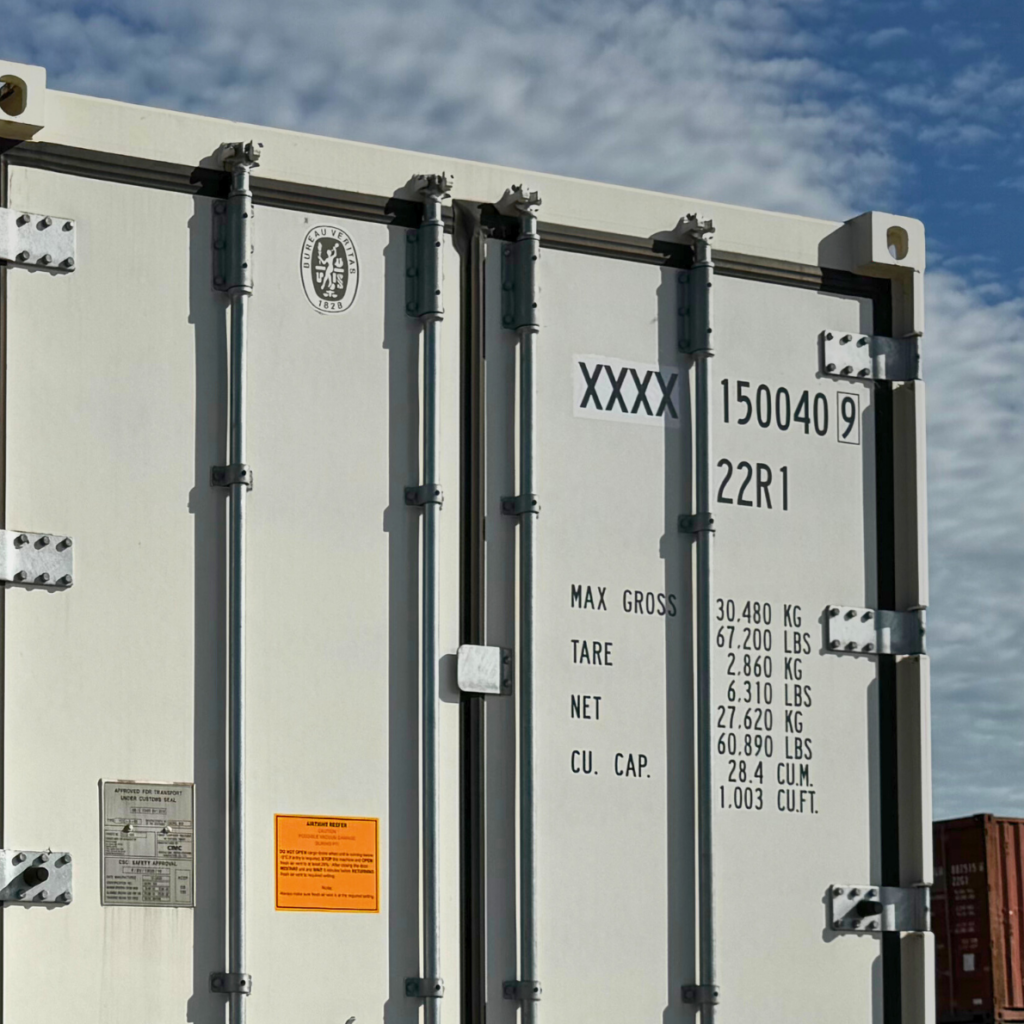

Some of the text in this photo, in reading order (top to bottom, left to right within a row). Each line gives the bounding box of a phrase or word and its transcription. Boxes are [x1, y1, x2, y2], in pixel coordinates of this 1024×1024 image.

[318, 300, 343, 310] 1828
[578, 361, 857, 440] XXXX 150040 9
[716, 458, 788, 511] 22R1
[570, 584, 677, 617] MAX GROSS
[783, 604, 802, 628] KG
[570, 639, 613, 666] TARE
[783, 630, 811, 655] LBS
[784, 657, 803, 681] KG
[570, 694, 602, 720] NET
[784, 683, 812, 708] LBS
[784, 710, 803, 734] KG
[785, 736, 813, 760] LBS
[570, 750, 651, 778] CU. CAP.
[728, 759, 764, 784] 28.4
